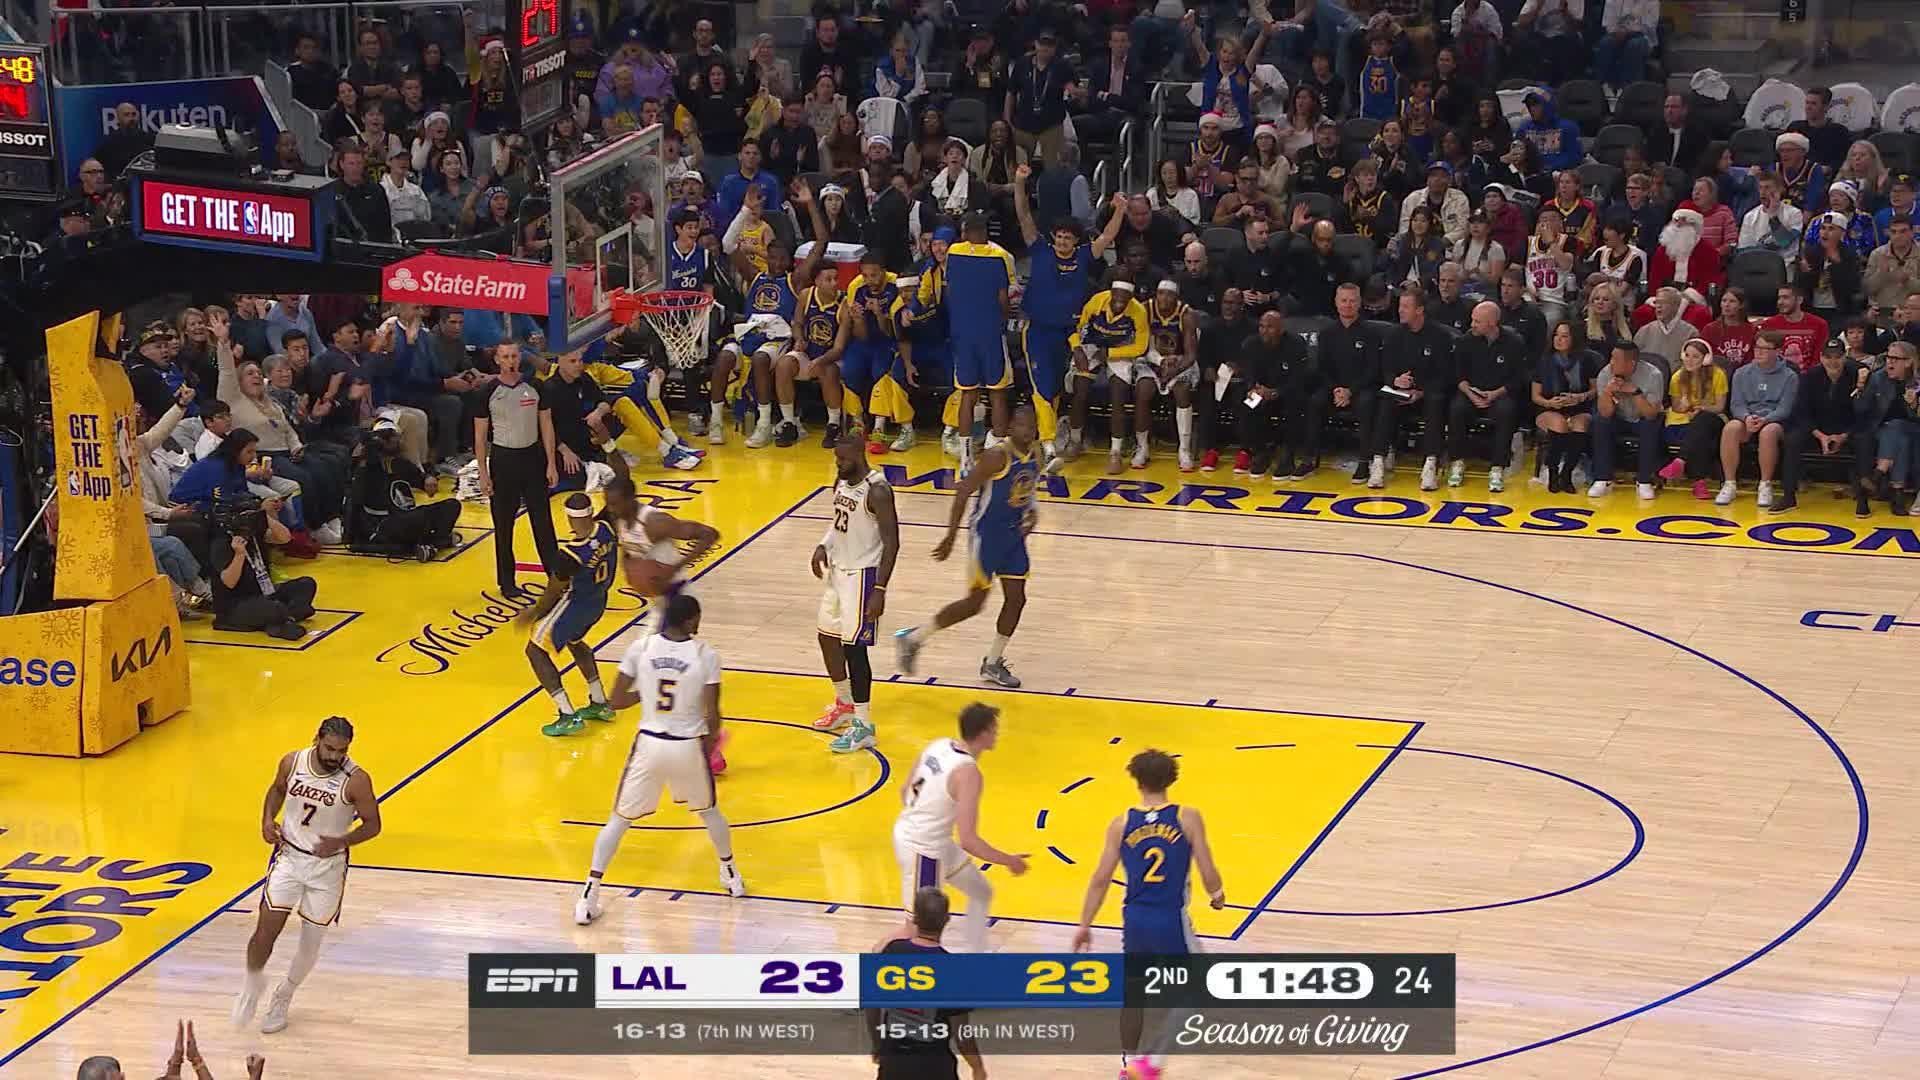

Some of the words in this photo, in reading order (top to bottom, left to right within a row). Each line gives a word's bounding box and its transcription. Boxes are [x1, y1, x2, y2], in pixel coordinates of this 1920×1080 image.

[535, 50, 567, 78] TISSOT
[161, 191, 198, 227] GET
[202, 196, 239, 231] THE
[260, 203, 295, 243] App
[680, 276, 698, 289] 30
[1533, 269, 1559, 289] 30
[69, 413, 99, 440] GET
[71, 442, 103, 468] THE
[83, 470, 112, 501] App
[834, 507, 849, 533] 23
[656, 679, 678, 712] 5
[289, 780, 337, 807] LAKERS
[301, 802, 318, 827] 7
[1142, 846, 1167, 883] 2
